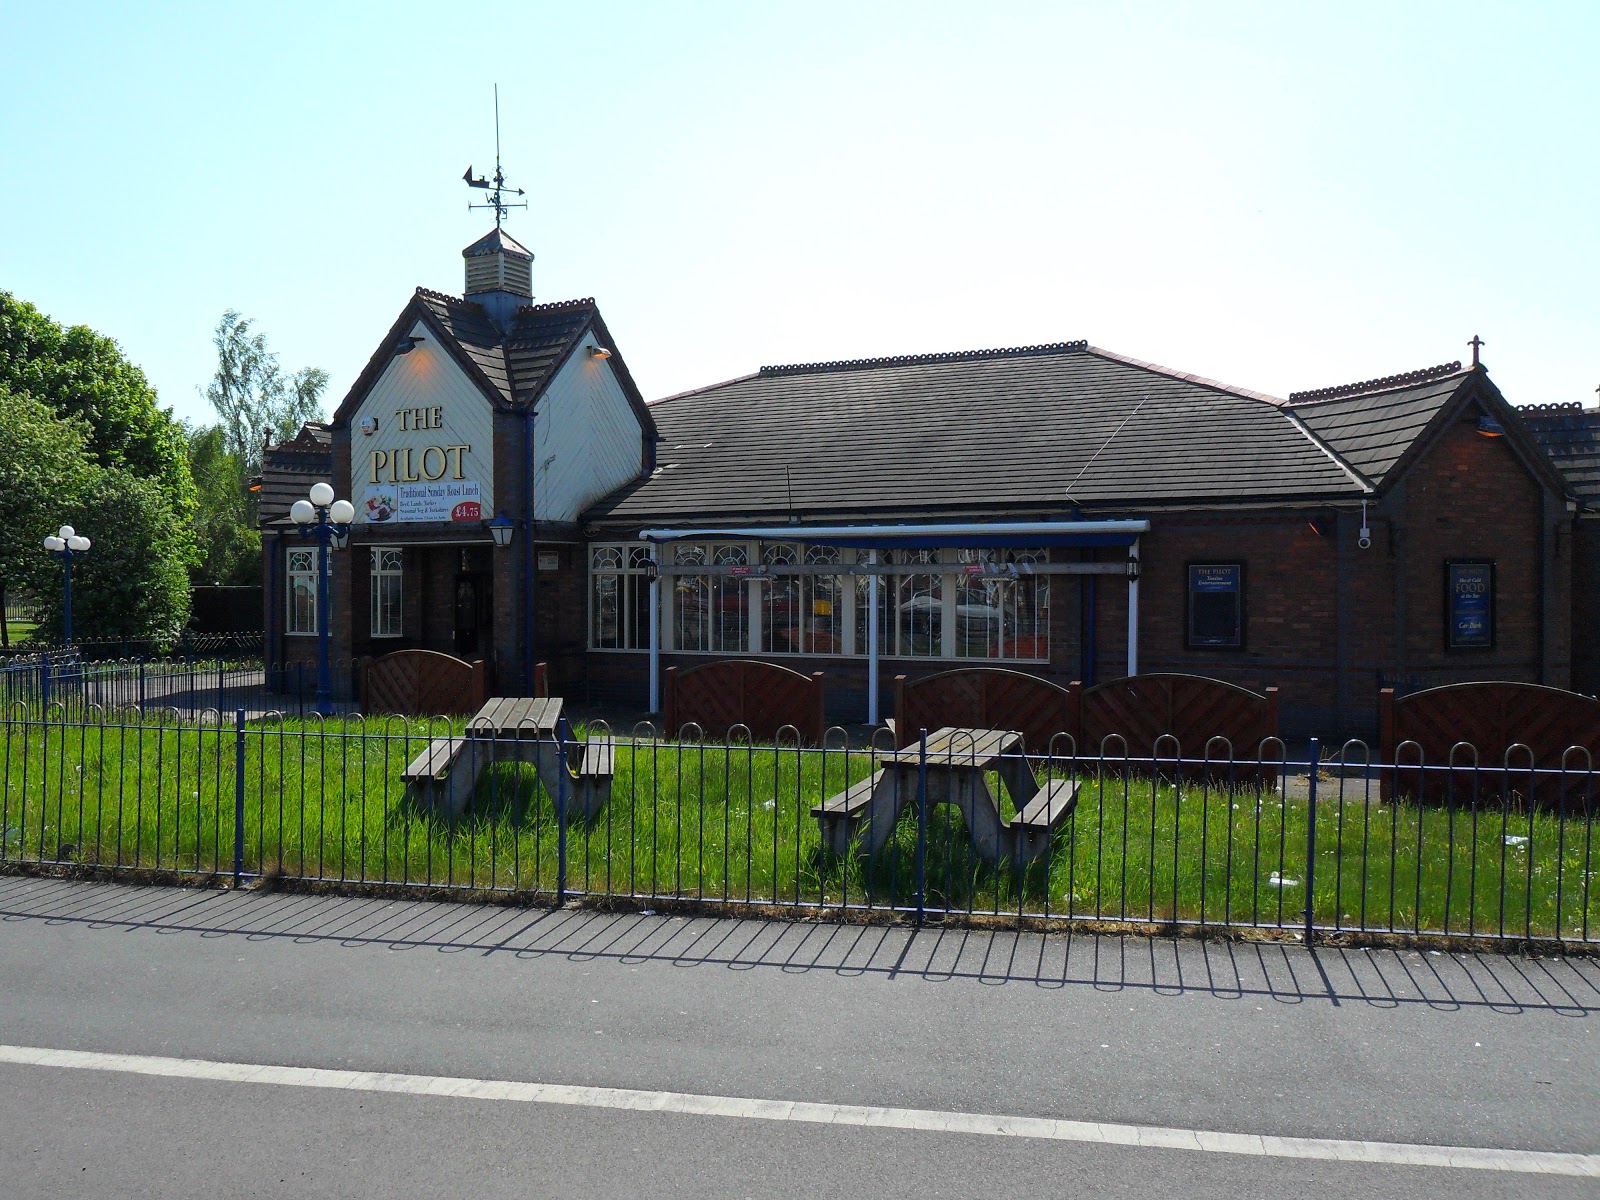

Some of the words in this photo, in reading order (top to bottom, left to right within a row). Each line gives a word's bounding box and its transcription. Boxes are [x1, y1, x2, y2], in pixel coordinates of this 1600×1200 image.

[396, 406, 442, 431] THE
[369, 445, 471, 483] PILOT
[400, 485, 427, 498] Traditional
[428, 485, 445, 498] Sunday
[447, 485, 460, 496] Roast
[462, 483, 478, 496] Lunch
[455, 505, 479, 517] £4.75
[1456, 583, 1485, 592] FOOD
